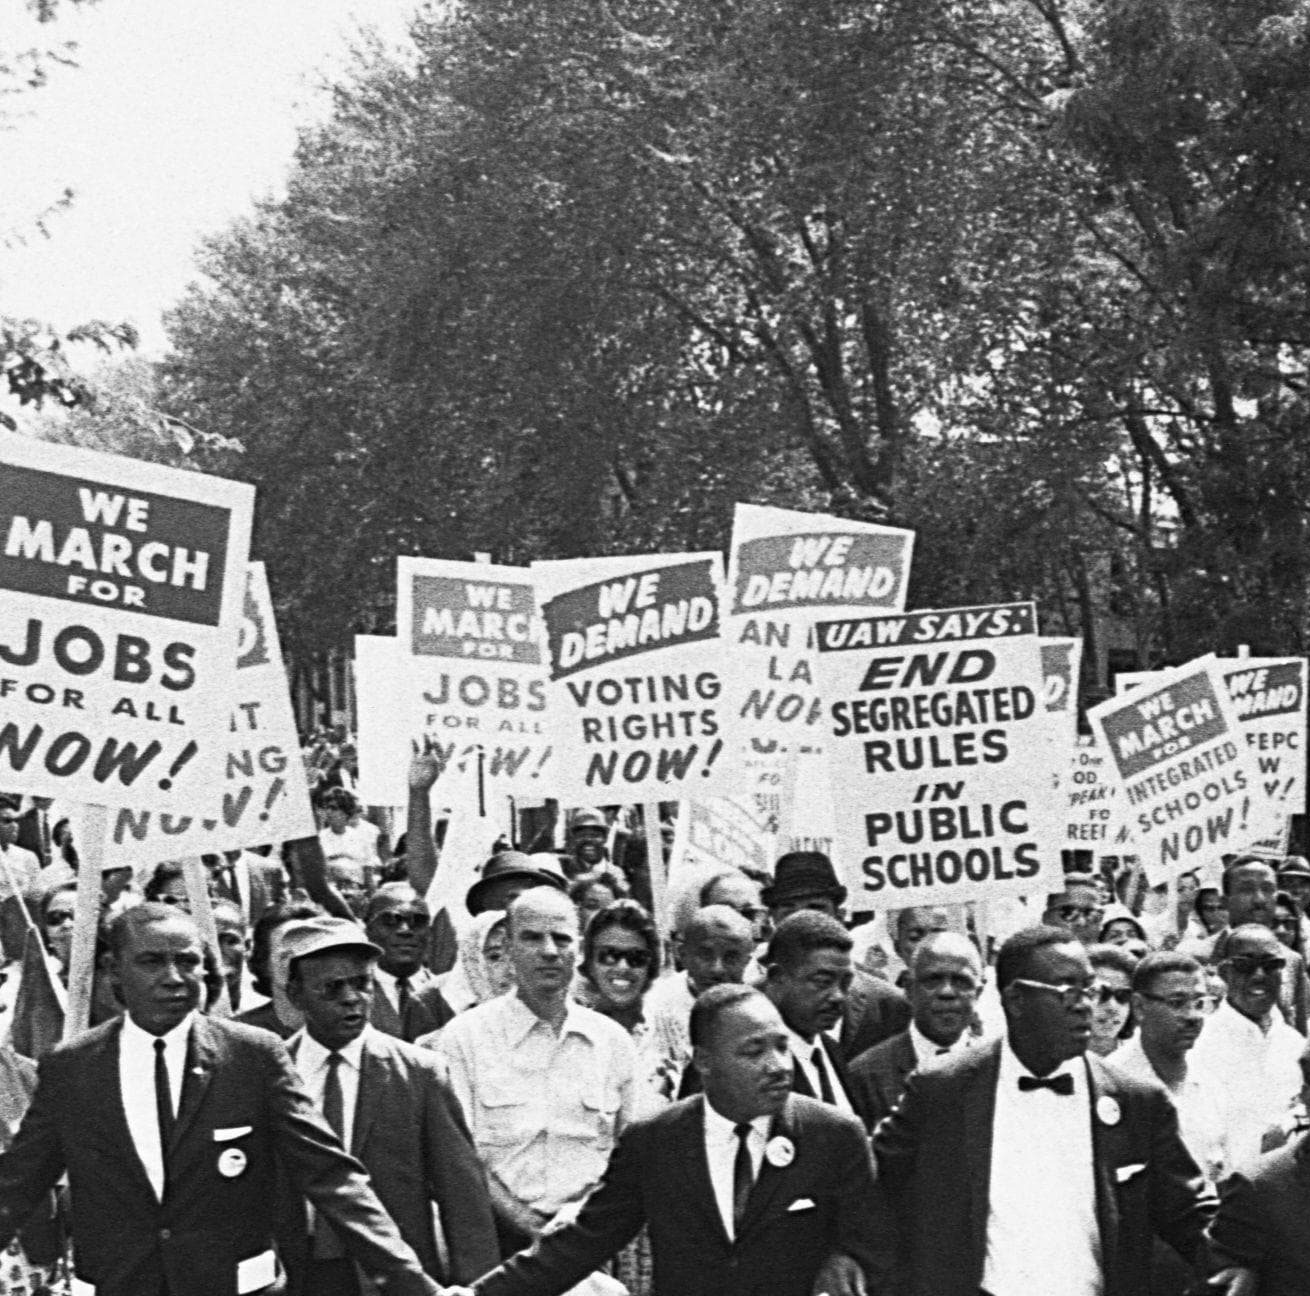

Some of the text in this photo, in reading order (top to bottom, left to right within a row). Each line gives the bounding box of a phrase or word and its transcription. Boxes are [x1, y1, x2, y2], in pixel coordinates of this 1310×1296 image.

[79, 488, 149, 532] WE
[6, 516, 209, 590] MARCH
[789, 536, 854, 568] WE
[68, 575, 148, 608] FOR
[465, 584, 512, 610] WE
[599, 573, 661, 619] WE
[741, 566, 895, 607] DEMAND
[558, 596, 713, 669] DEMAND
[738, 619, 790, 649] AN
[825, 619, 906, 648] UAW
[913, 608, 1028, 641] SAYS:
[0, 618, 196, 691] JOBS
[463, 641, 514, 659] FOR
[768, 656, 812, 685] LA
[858, 649, 996, 691] END
[1, 678, 185, 726] FOR ALL
[422, 673, 546, 712] JOBS
[566, 672, 722, 708] VOTING
[1229, 668, 1270, 698] WE
[426, 714, 543, 735] FOR ALL
[582, 709, 719, 744] RIGHTS
[831, 685, 1036, 737] SEGREGATED
[1137, 692, 1175, 720] WE
[1118, 698, 1215, 760] MARCH
[1153, 735, 1191, 760] FOR
[1246, 731, 1299, 750] FEPC
[0, 722, 198, 791] NOW!
[428, 742, 553, 779] NW!
[585, 738, 724, 787] NOW!
[864, 729, 1009, 773] RULES
[912, 781, 965, 802] IN
[1127, 741, 1237, 805] INTEGRATED
[1137, 769, 1247, 833] SCHOOLS
[864, 800, 1029, 847] PUBLIC
[1160, 796, 1250, 865] NOW!
[862, 842, 1041, 891] SCHOOLS
